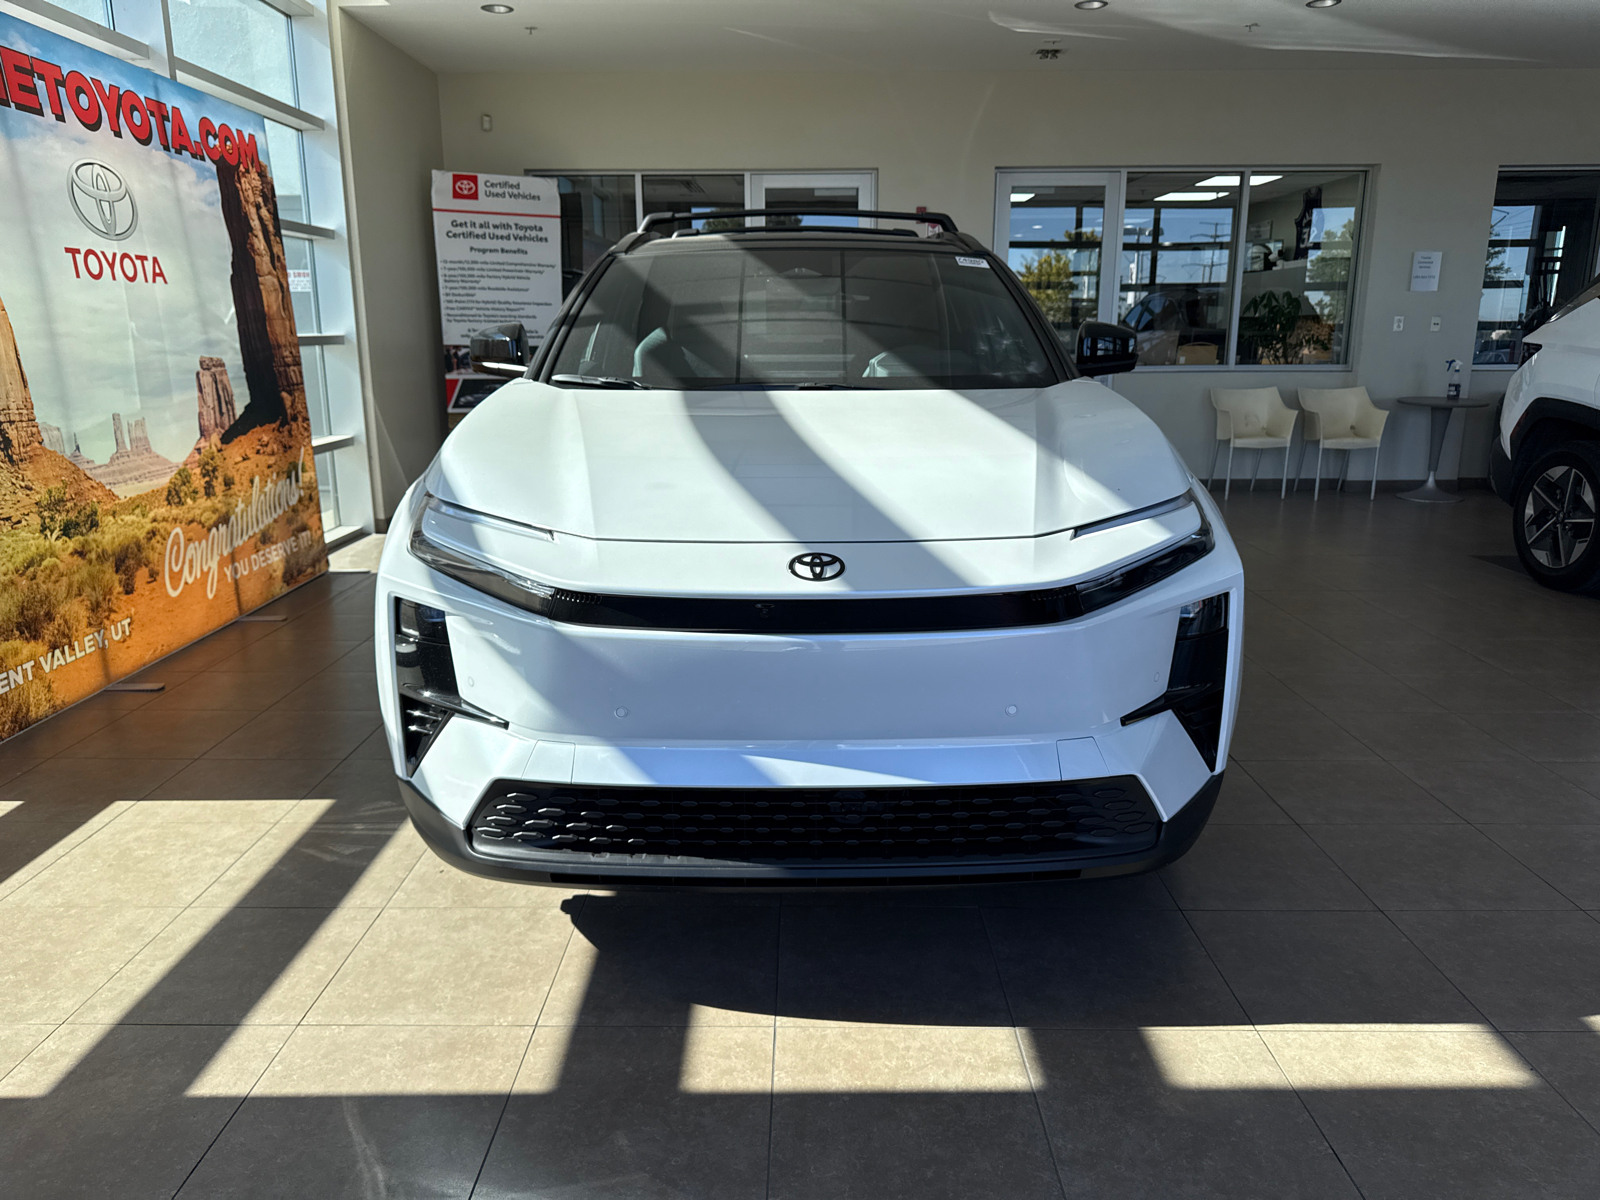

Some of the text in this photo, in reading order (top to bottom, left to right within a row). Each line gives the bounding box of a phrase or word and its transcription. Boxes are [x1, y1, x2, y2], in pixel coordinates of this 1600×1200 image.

[484, 179, 520, 190] Certified
[484, 190, 541, 202] Used Vehicles
[450, 219, 543, 233] Get it all with Toyota
[446, 230, 549, 243] Certified Used Vehicles
[470, 246, 528, 256] Program Benefits
[64, 247, 168, 286] TOYOTA
[165, 446, 304, 600] Congratulations!
[224, 557, 250, 583] YOU
[250, 535, 299, 572] DESERVE
[0, 616, 131, 696] ENT VALLEY, UT
